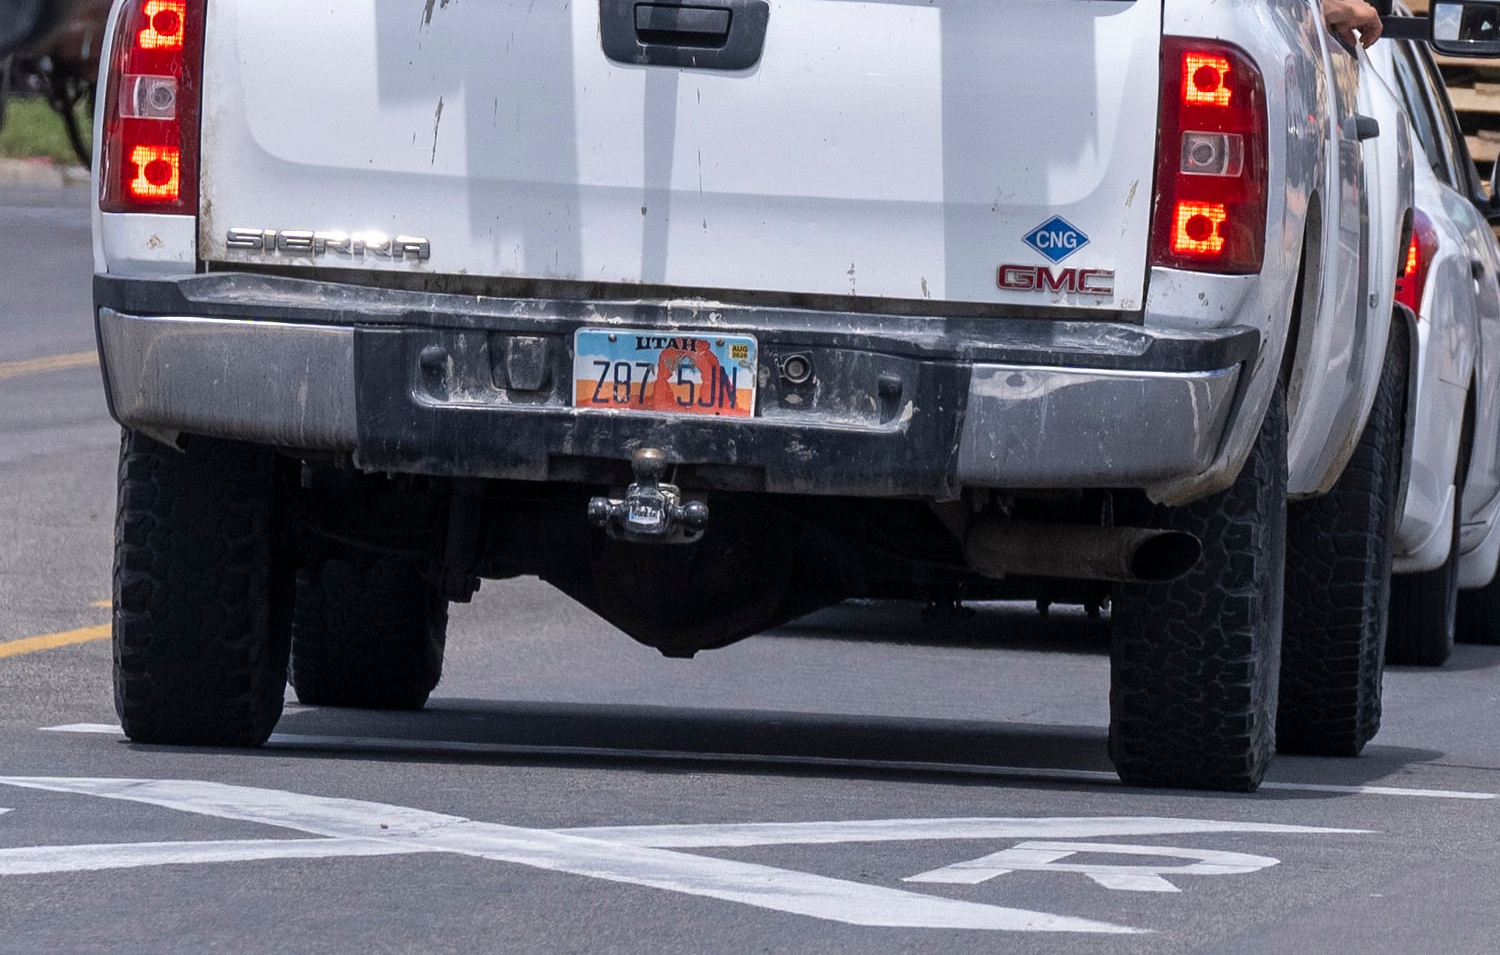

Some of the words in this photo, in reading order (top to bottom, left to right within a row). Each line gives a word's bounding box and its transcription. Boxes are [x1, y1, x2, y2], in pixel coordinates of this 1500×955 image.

[226, 227, 431, 260] SIERRA
[1036, 230, 1077, 249] CNG
[996, 264, 1115, 296] GMC
[635, 336, 698, 352] UTAH
[592, 360, 652, 405] Z87
[676, 362, 738, 410] 5JN
[902, 840, 1281, 893] R
